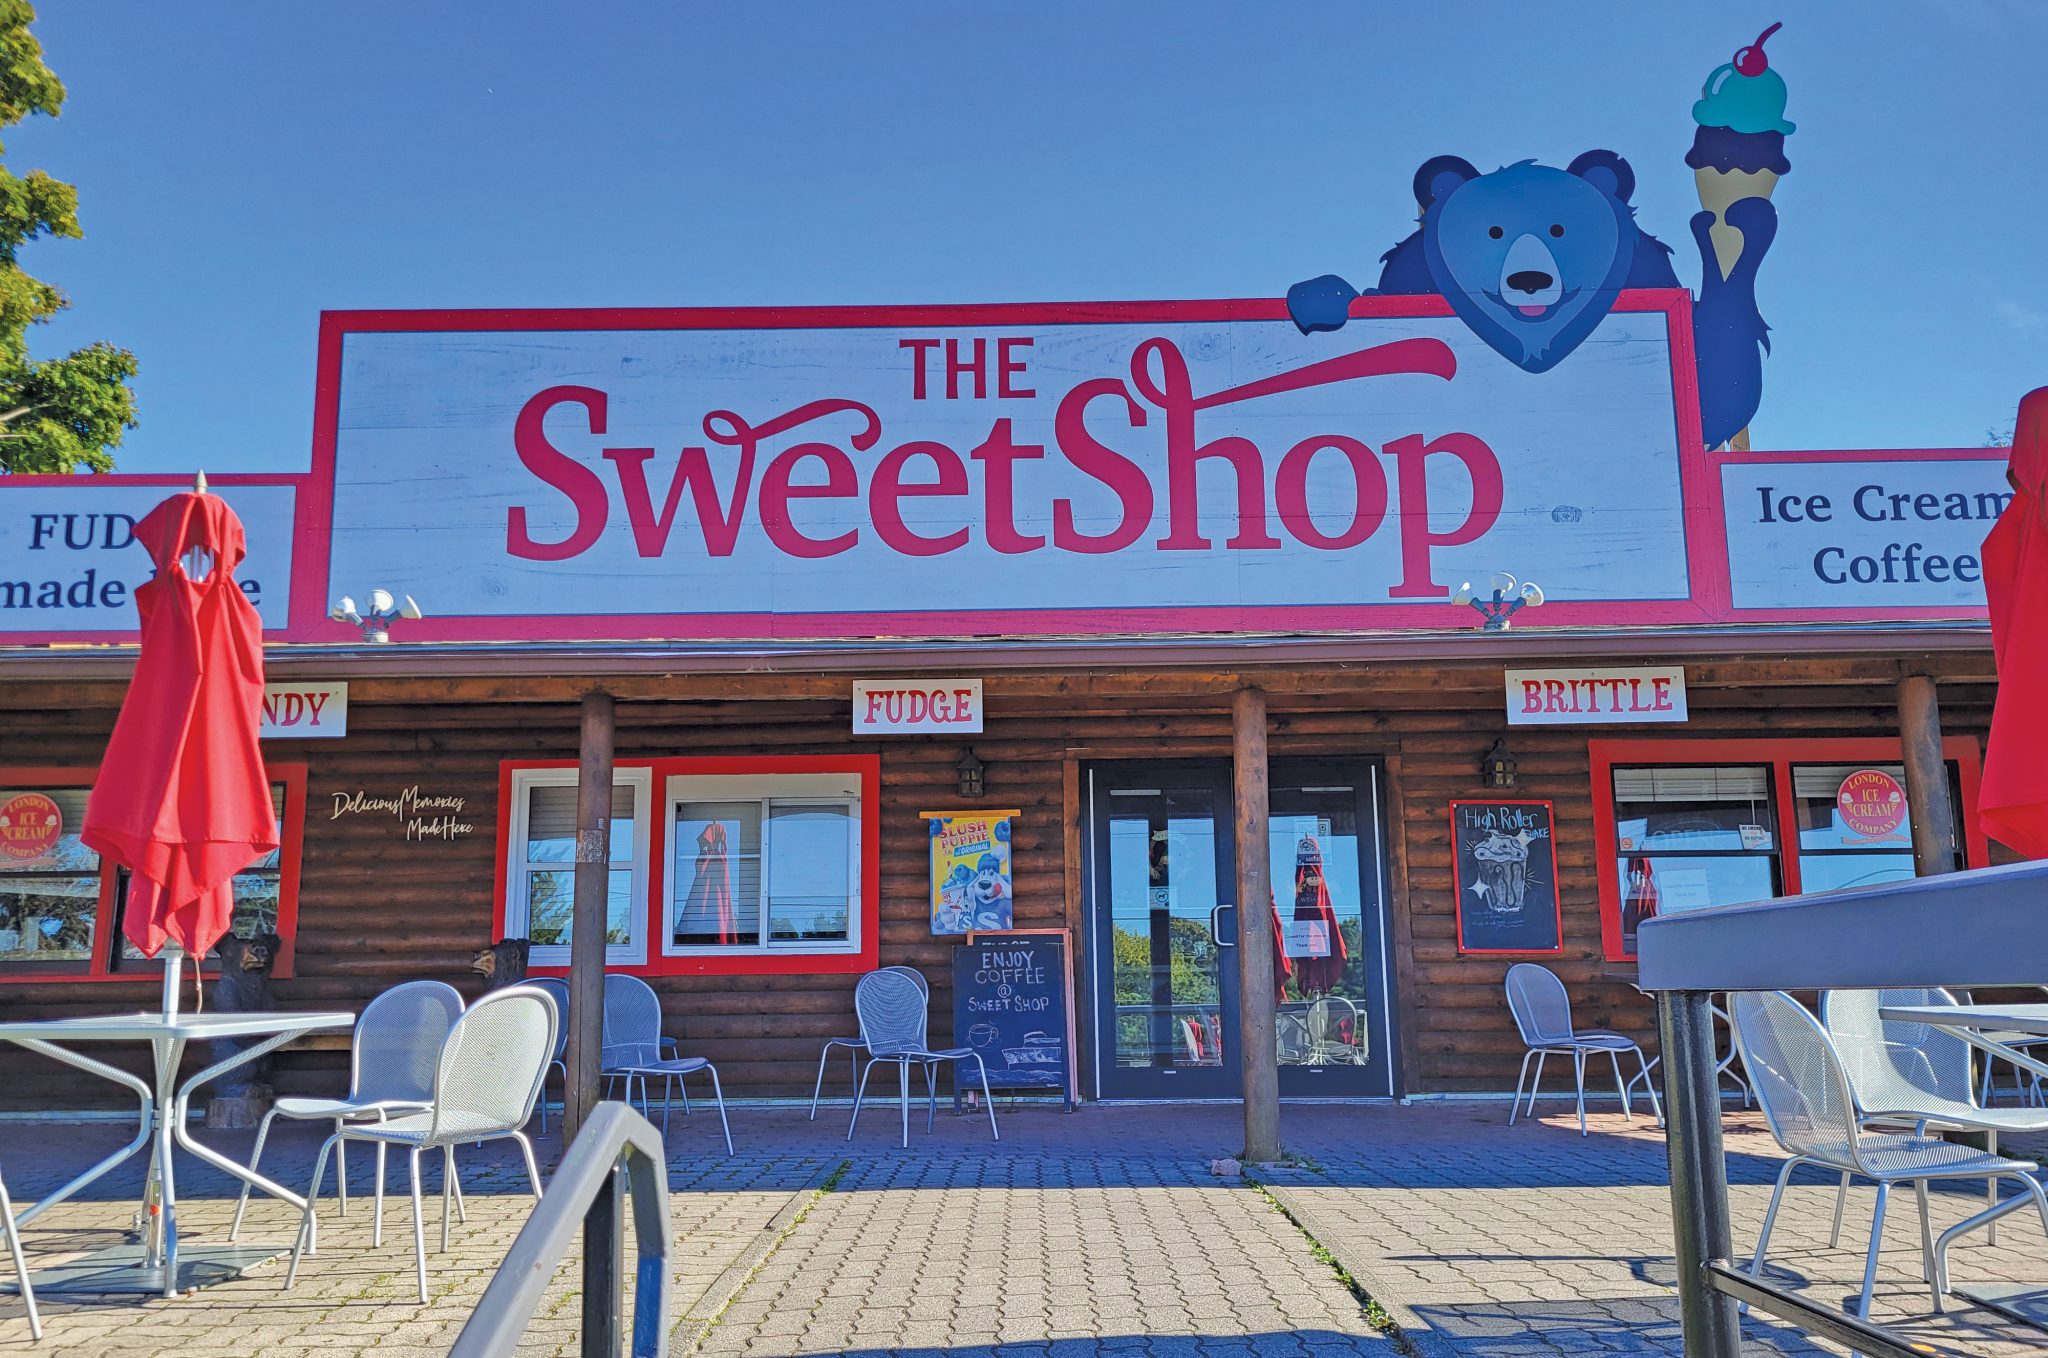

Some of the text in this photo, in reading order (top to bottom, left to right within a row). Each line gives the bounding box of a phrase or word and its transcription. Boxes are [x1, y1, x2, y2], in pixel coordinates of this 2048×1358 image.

[899, 337, 1036, 400] THE
[1756, 485, 2016, 523] Ice Cream
[28, 514, 137, 550] FUD
[1813, 543, 1980, 585] Coffee
[1521, 677, 1673, 713] BRITTLE
[259, 692, 331, 726] NDY
[863, 689, 972, 723] FUDGE
[1848, 773, 1890, 790] LONDON
[1862, 788, 1880, 802] ICE
[8, 797, 49, 813] LONDON
[1853, 803, 1892, 817] CREAM
[19, 812, 38, 825] ICE
[1464, 806, 1538, 832] High Roller
[1849, 818, 1897, 834] COMPANY
[7, 826, 46, 840] CREAM
[940, 821, 987, 839] SLUSH
[1, 841, 49, 857] COMPANY
[982, 950, 1035, 969] ENJOY
[975, 967, 1046, 985] COFFEE
[997, 983, 1012, 998] @
[968, 995, 1049, 1012] SWEET SHOP
